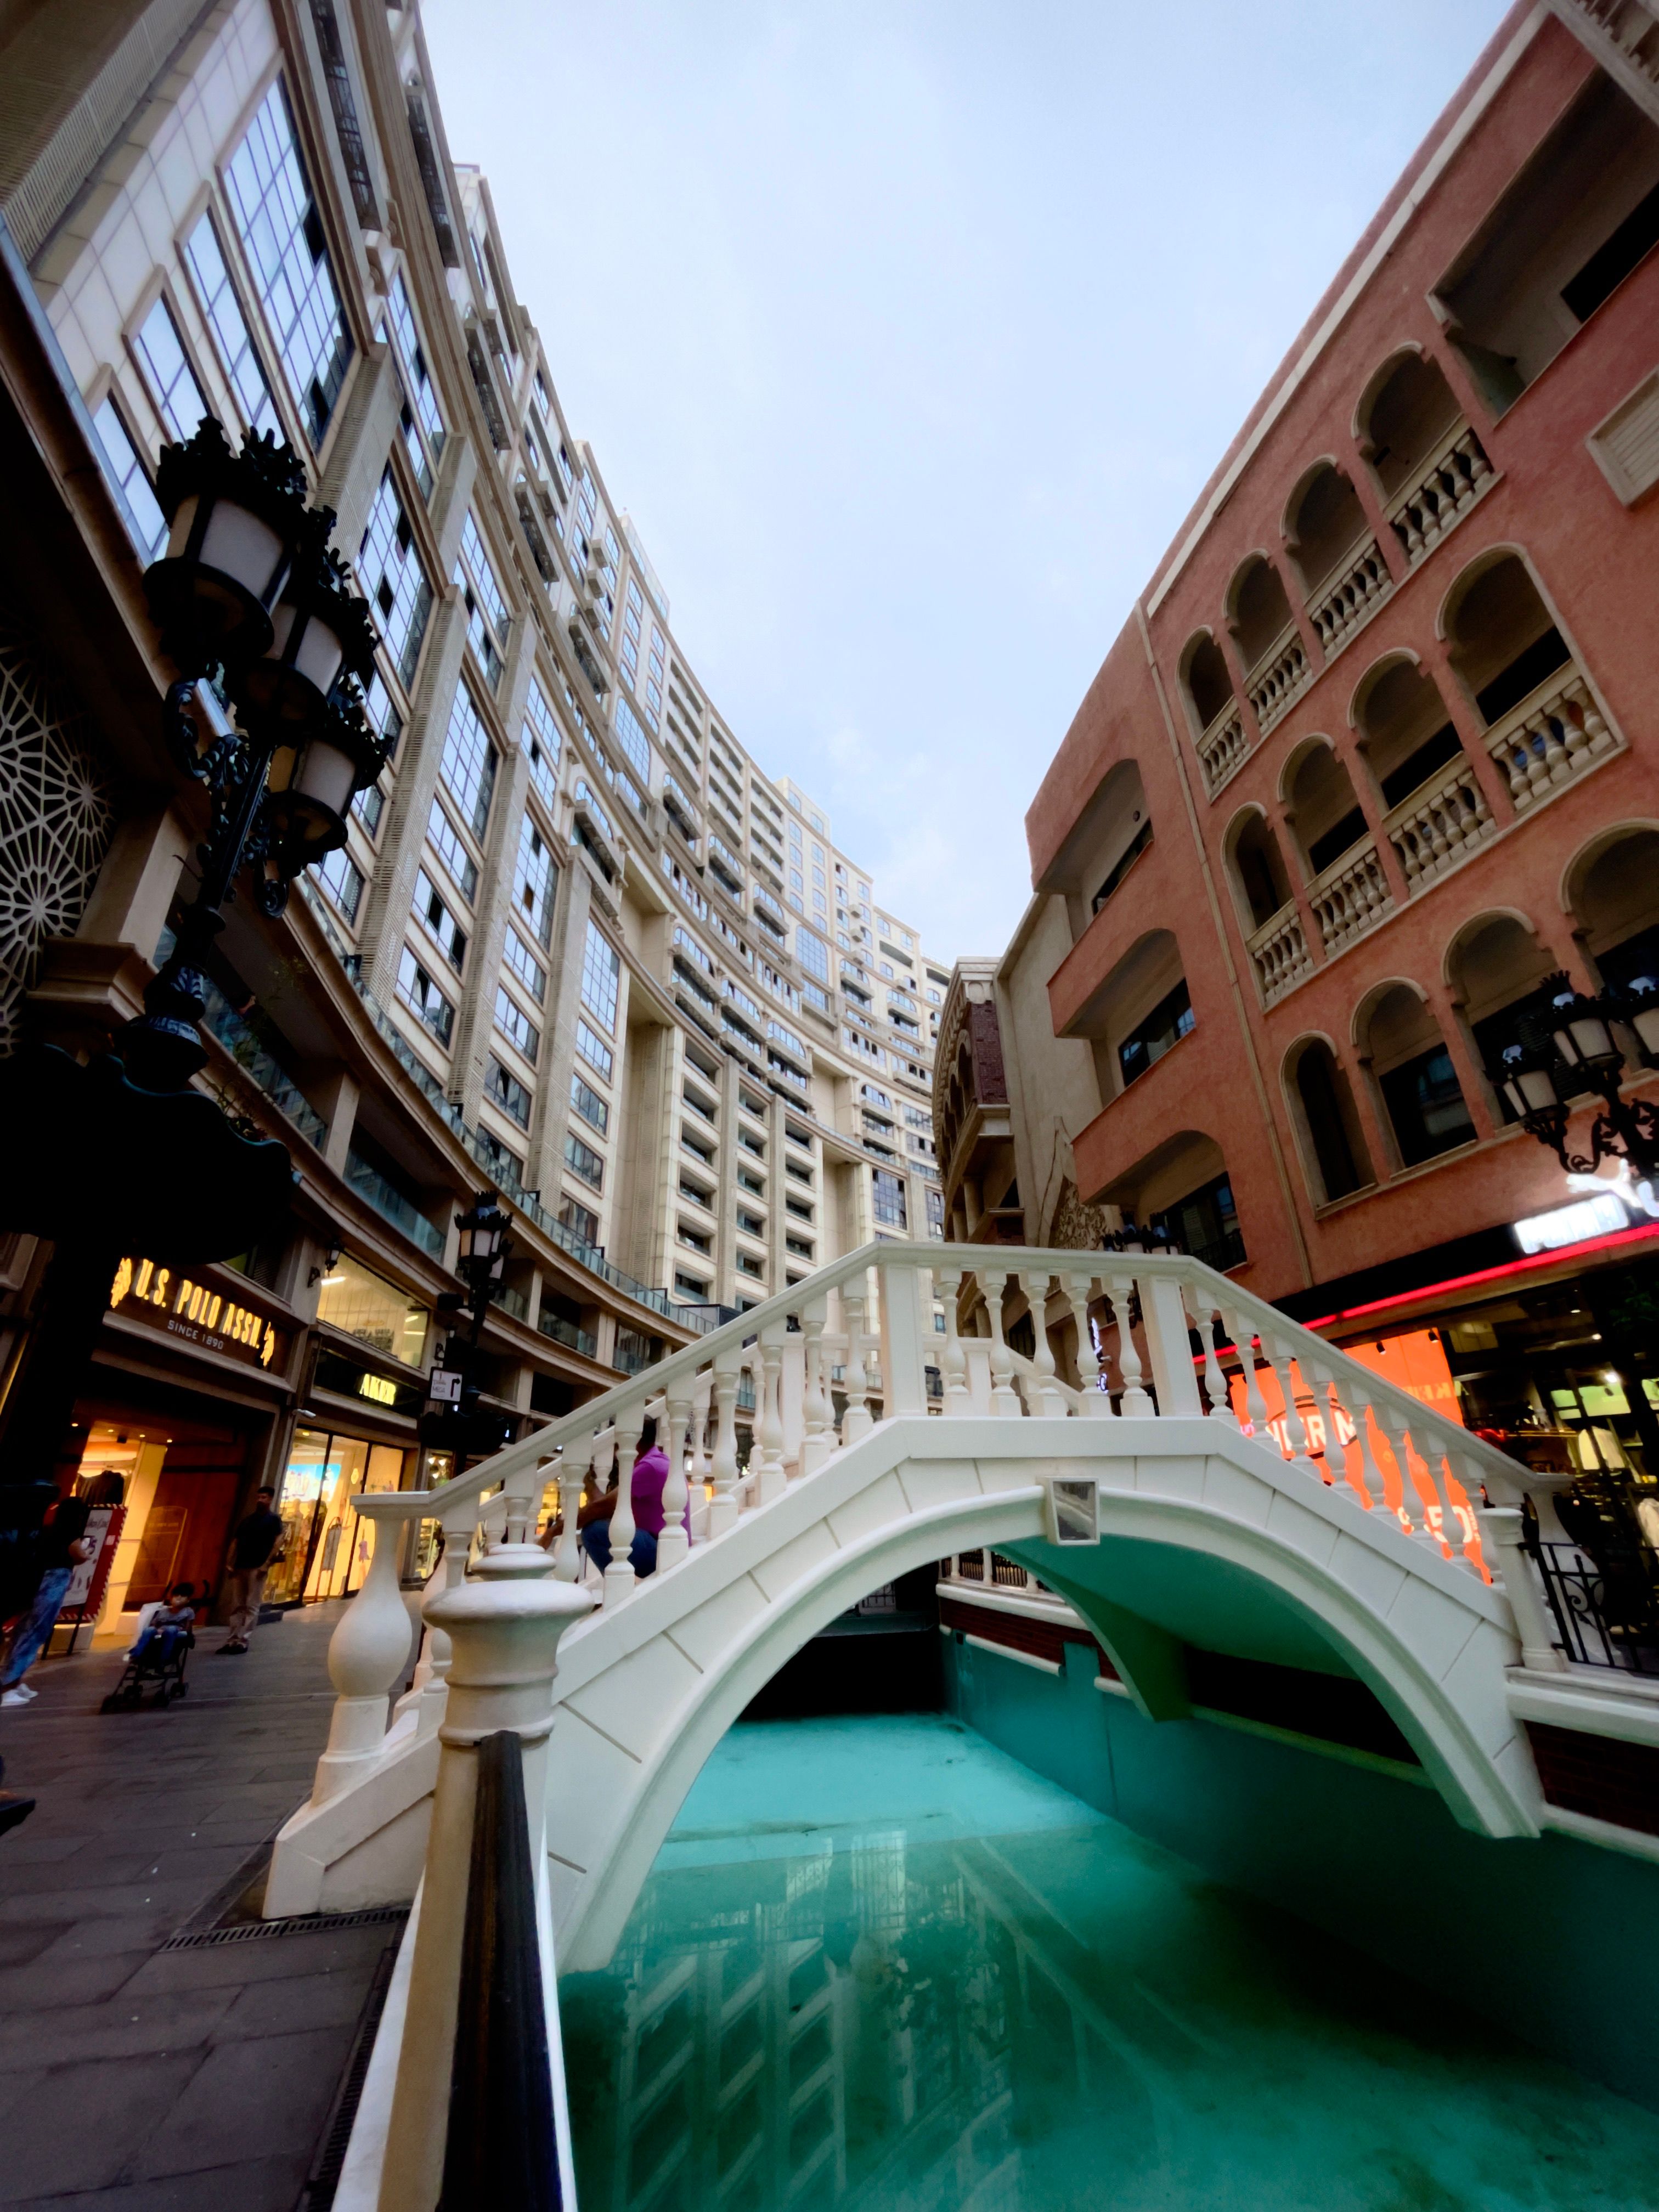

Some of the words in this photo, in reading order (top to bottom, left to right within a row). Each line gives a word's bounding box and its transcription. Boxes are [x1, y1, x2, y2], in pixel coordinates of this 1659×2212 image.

[136, 1259, 170, 1308] U.S.
[177, 1279, 222, 1329] POLO
[222, 1303, 262, 1349] ASSN.
[167, 1319, 199, 1340] SINCE
[202, 1333, 224, 1350] 1890
[359, 1374, 396, 1406] AKER
